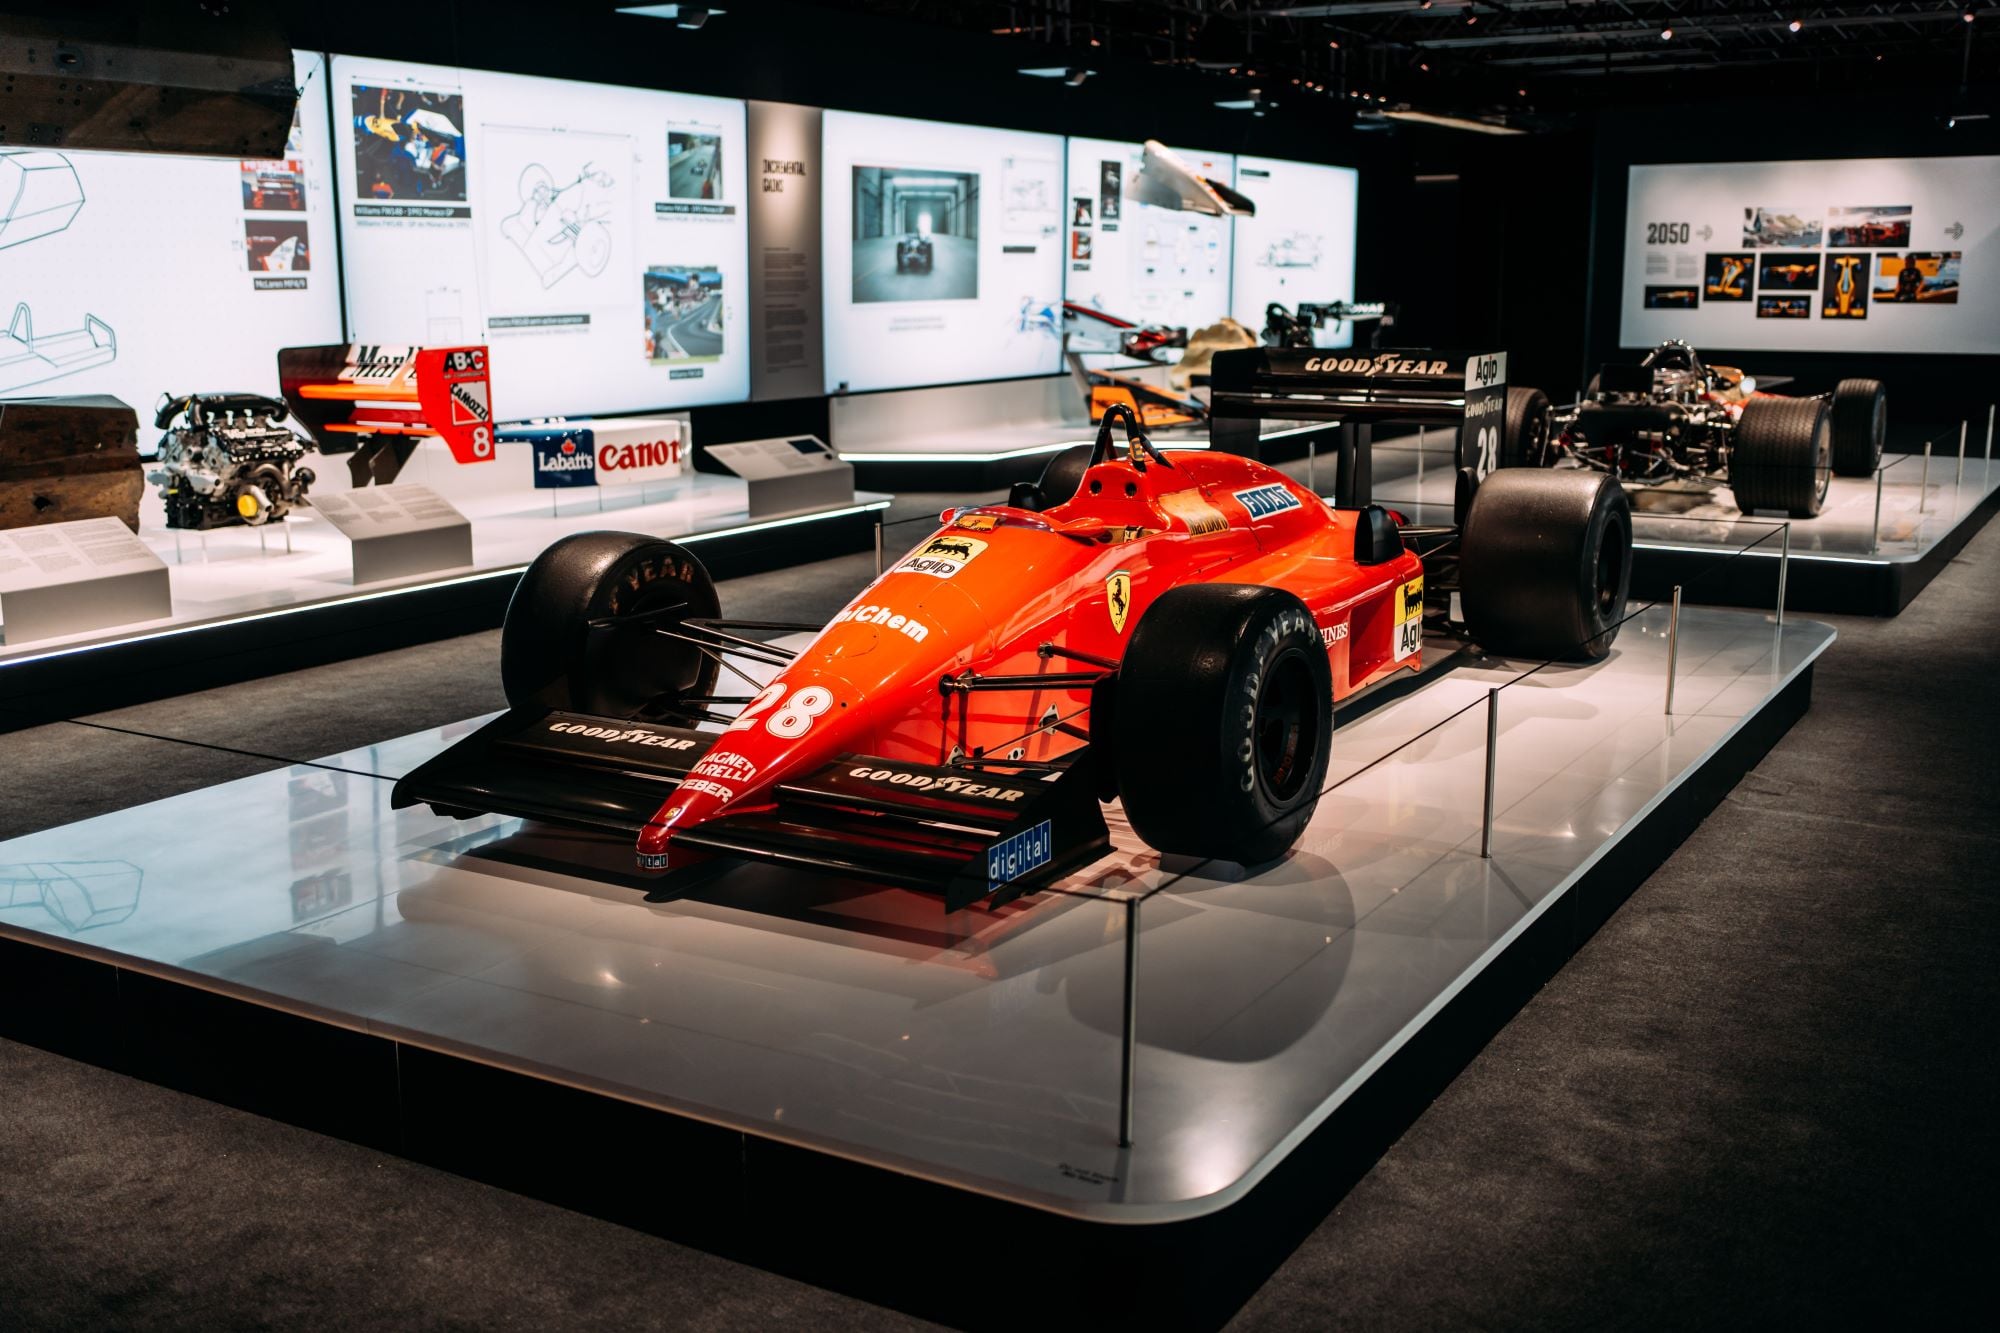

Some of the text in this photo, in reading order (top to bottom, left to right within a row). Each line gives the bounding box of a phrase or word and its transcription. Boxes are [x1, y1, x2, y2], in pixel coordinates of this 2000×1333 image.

[1647, 222, 1690, 244] 2050
[1305, 354, 1448, 376] GOODYEAR
[1475, 356, 1498, 386] Agip
[450, 382, 489, 421] CAMOZZI
[473, 426, 491, 457] 8
[1477, 425, 1498, 483] 28
[539, 452, 594, 472] Labatt's
[1242, 490, 1297, 513] FIAT
[900, 557, 956, 575] Agip
[1400, 616, 1422, 653] Agi
[727, 682, 834, 739] 28
[549, 722, 696, 751] GOODYEAR
[849, 767, 1025, 802] GOODYEAR
[990, 831, 1048, 879] digital
